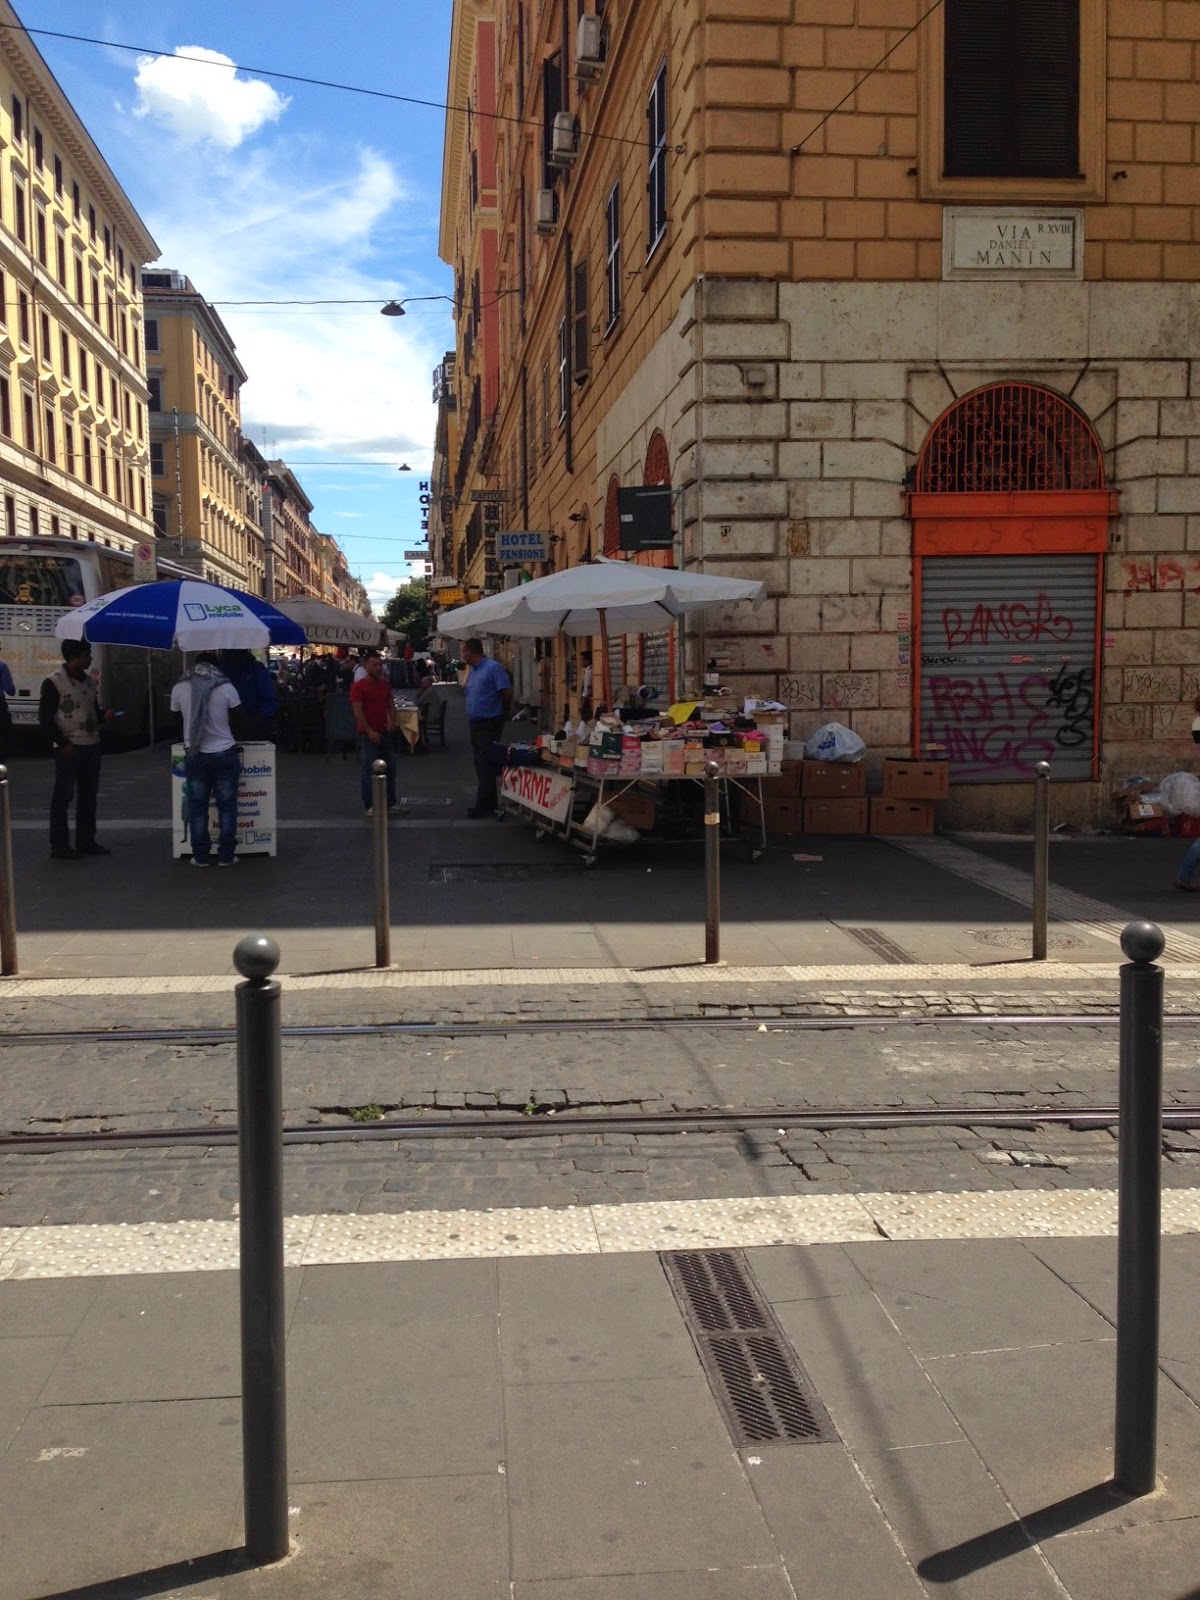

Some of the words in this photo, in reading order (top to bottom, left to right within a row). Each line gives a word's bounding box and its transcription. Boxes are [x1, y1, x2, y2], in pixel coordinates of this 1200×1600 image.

[997, 225, 1031, 239] VIA
[989, 240, 1037, 250] DANIELE
[976, 250, 1051, 264] MANIN
[500, 533, 544, 546] HOTEL
[500, 548, 546, 559] PENSIONE
[205, 603, 242, 613] Lyca
[208, 611, 244, 619] mobile
[306, 625, 372, 641] LUCIANO
[238, 789, 268, 798] iamate
[509, 766, 553, 809] FIRME
